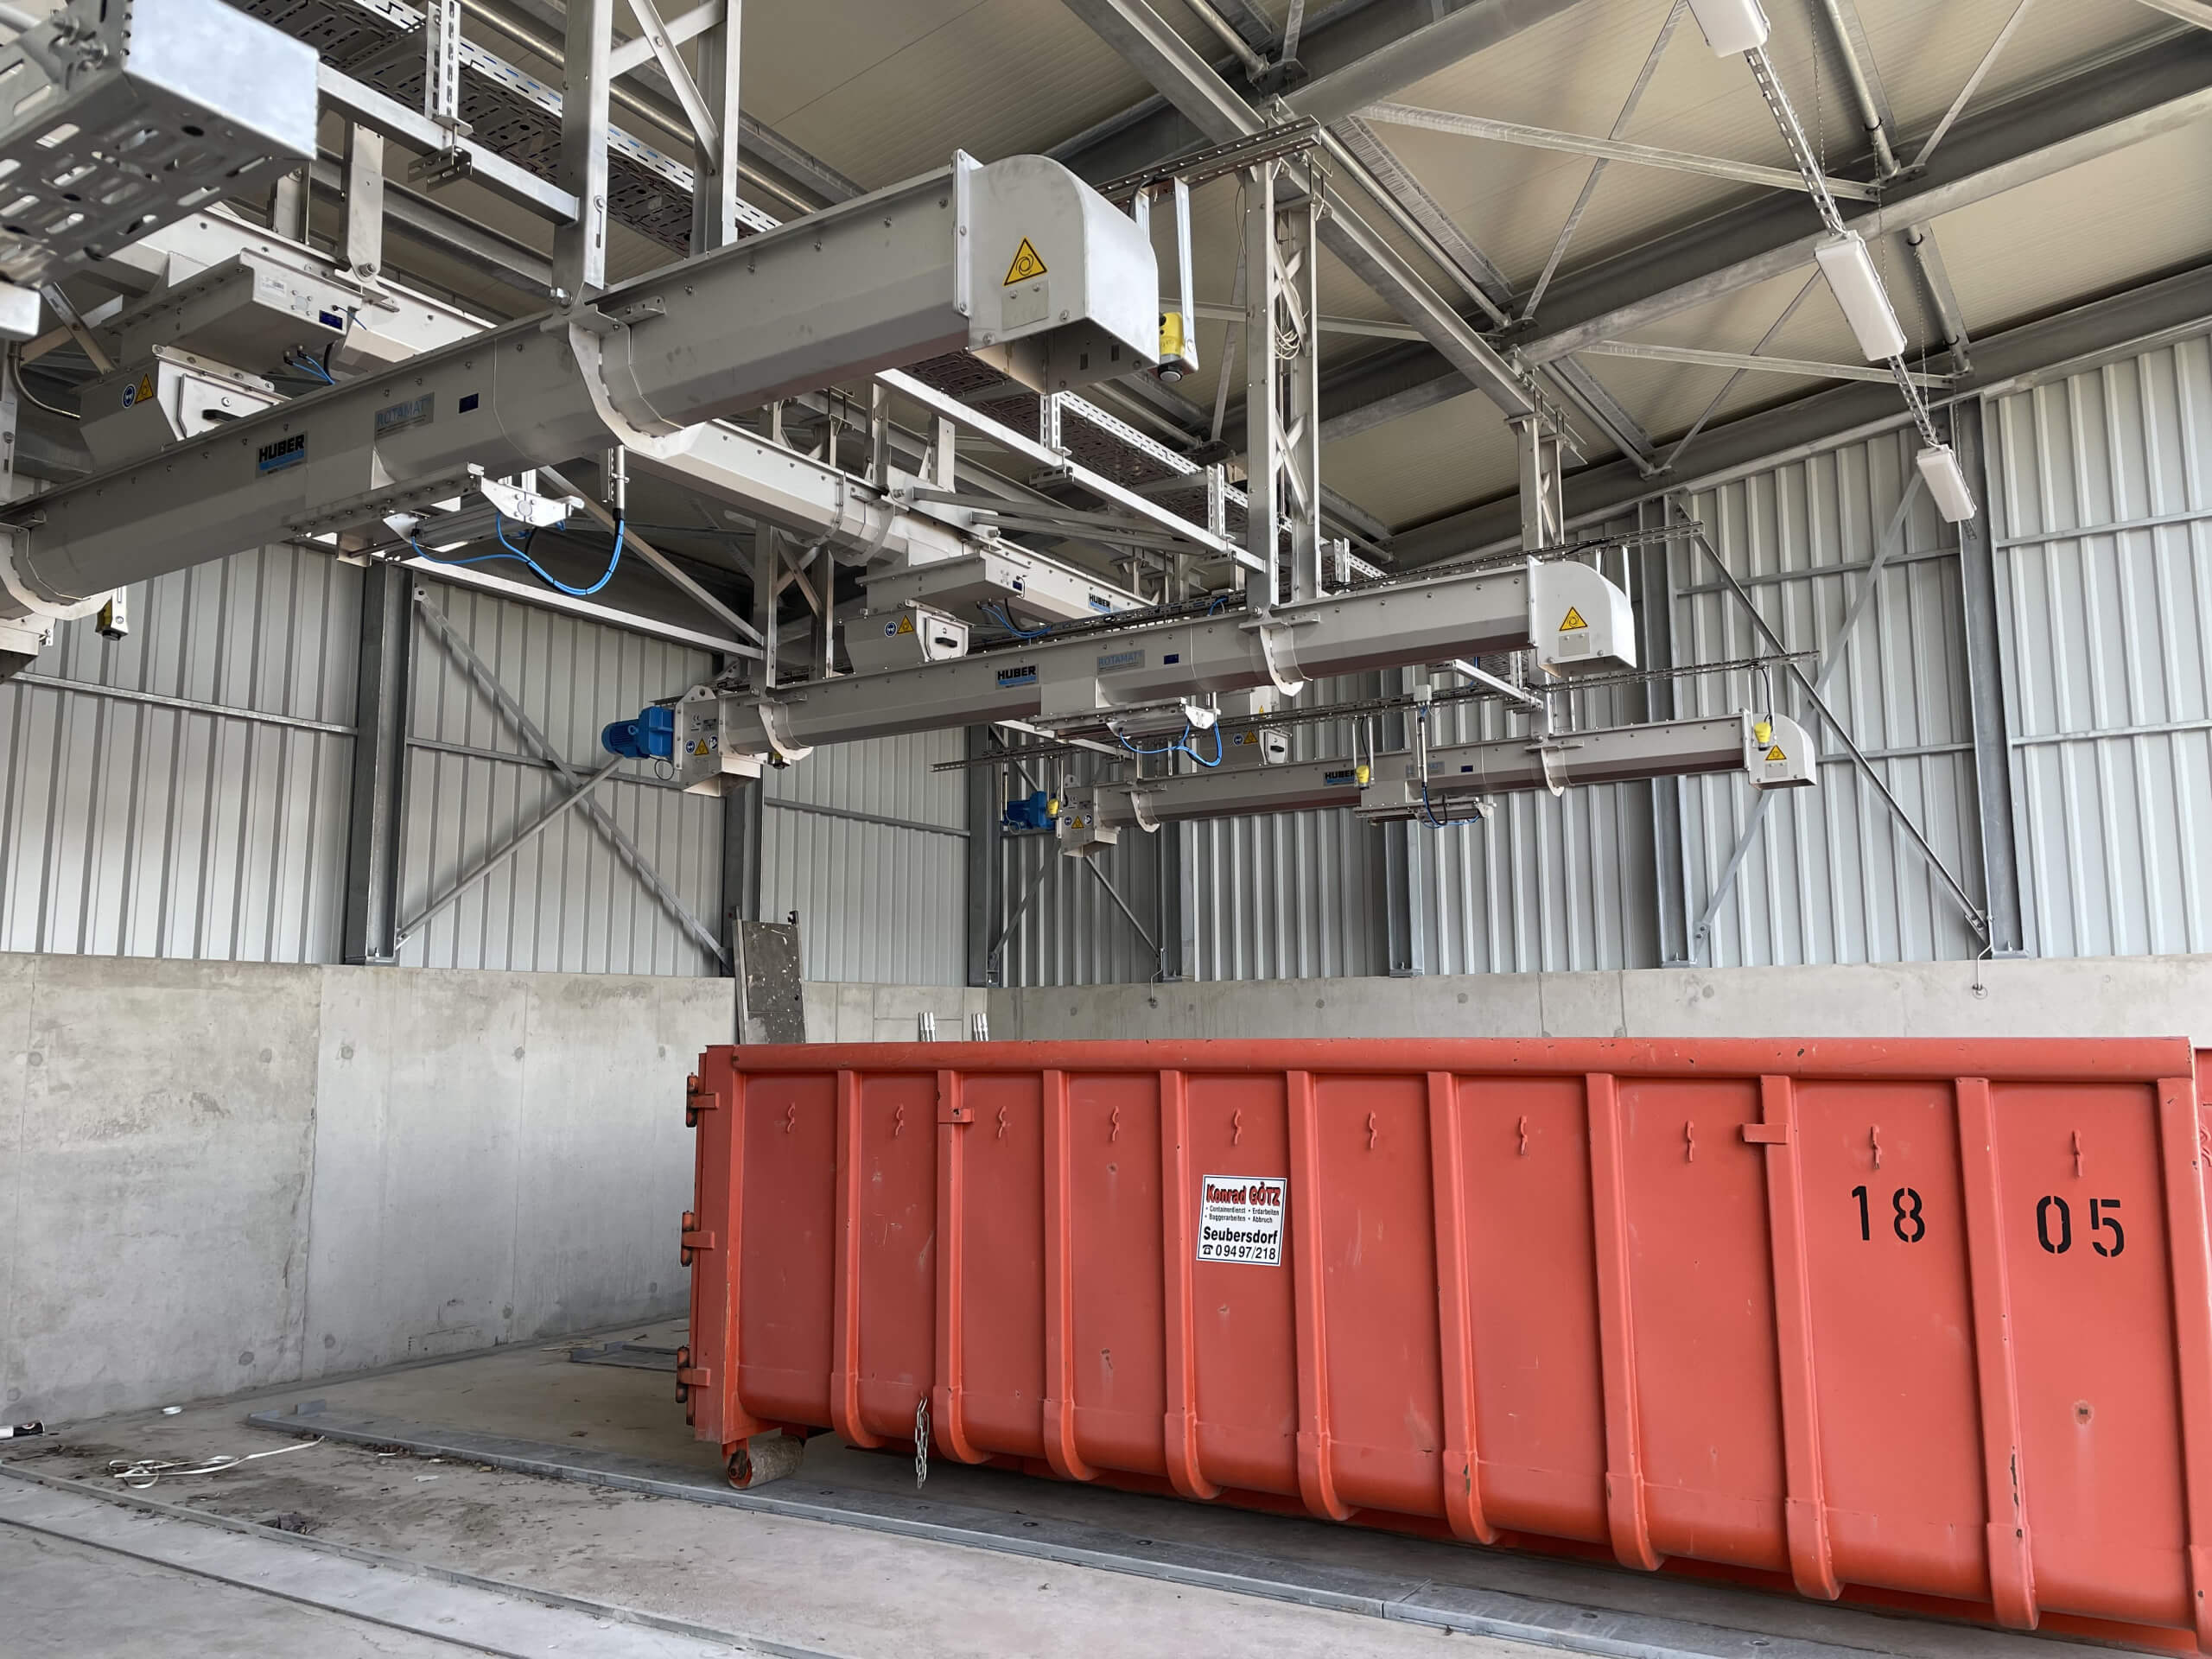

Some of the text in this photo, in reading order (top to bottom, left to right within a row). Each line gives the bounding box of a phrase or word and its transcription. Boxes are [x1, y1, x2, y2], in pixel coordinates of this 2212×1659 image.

[258, 434, 305, 463] HUBER
[1090, 594, 1110, 608] HUBER
[997, 665, 1036, 680] HUBER
[1206, 1181, 1281, 1206] Konrad GÖTZ
[1852, 1185, 2125, 1258] 18 05
[1203, 1226, 1278, 1244] Seubersdorf
